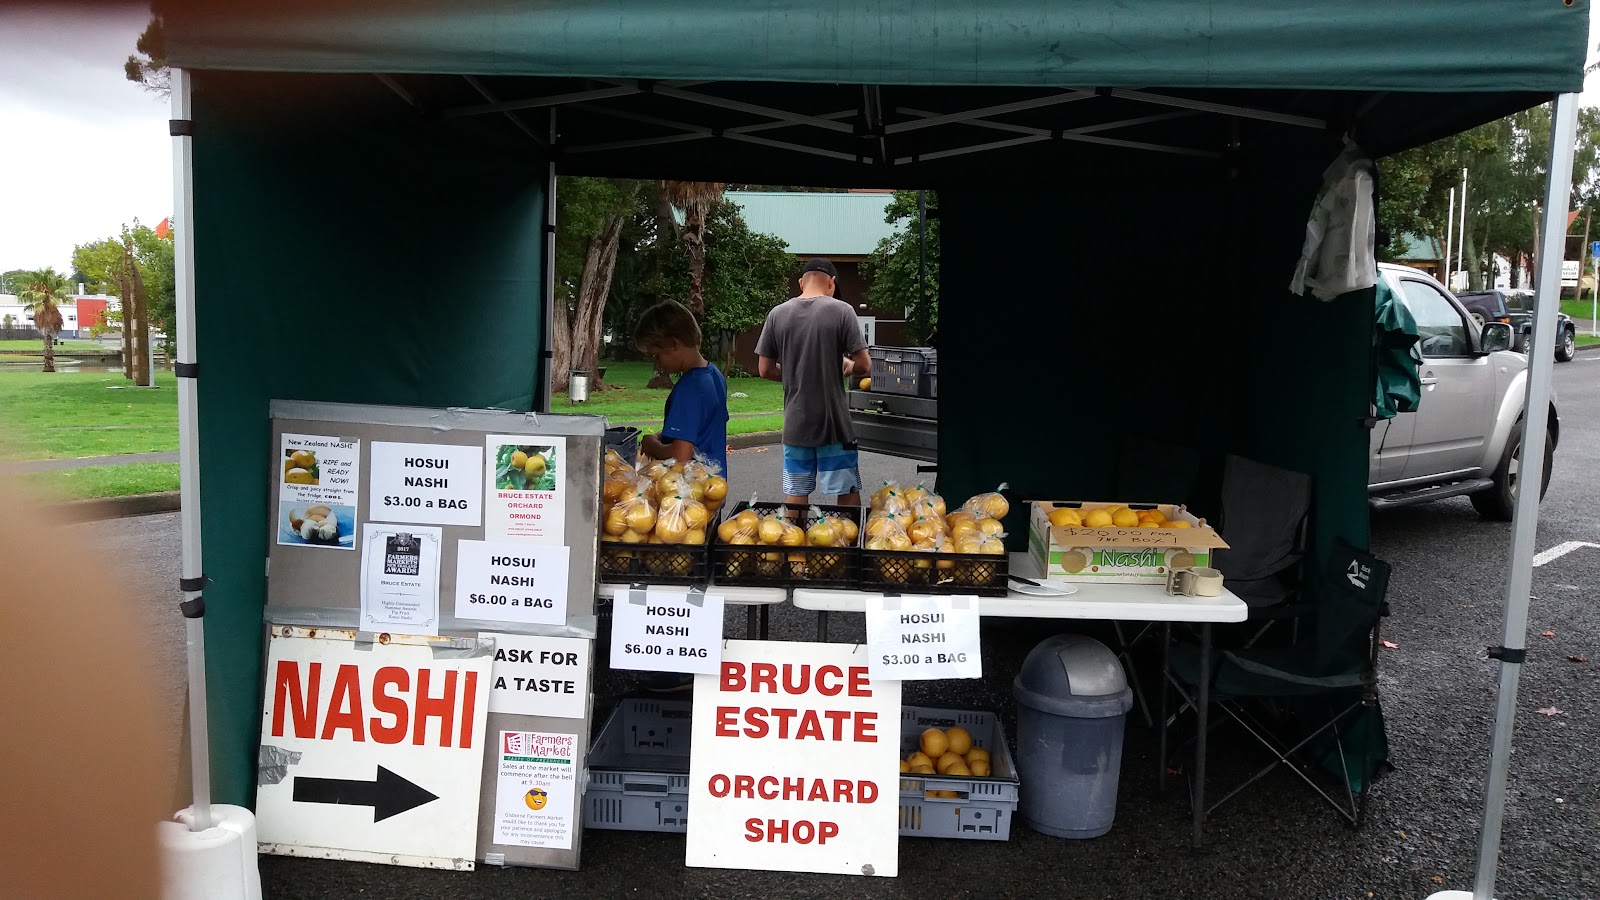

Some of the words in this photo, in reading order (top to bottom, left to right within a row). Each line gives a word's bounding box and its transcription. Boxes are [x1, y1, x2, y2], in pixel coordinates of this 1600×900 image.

[404, 457, 449, 469] HOSUI
[404, 476, 448, 488] NASHI
[384, 495, 421, 507] $3.00
[425, 500, 433, 508] a
[438, 498, 468, 510] BAG
[491, 556, 535, 568] HOSUI
[1100, 548, 1158, 568] Nashi
[491, 575, 534, 587] NASHI
[469, 593, 507, 605] $6.00
[511, 598, 519, 606] a
[524, 597, 553, 608] BAG
[646, 606, 690, 618] HOSUI
[900, 613, 944, 624] HOSUI
[646, 625, 689, 636] NASHI
[902, 633, 945, 644] NASHI
[494, 648, 533, 663] ASK
[540, 651, 578, 666] FOR
[624, 643, 662, 655] $6.00
[666, 648, 674, 656] a
[679, 647, 708, 658] BAG
[882, 654, 920, 666] $3.00
[925, 656, 932, 664] a
[938, 653, 967, 663] BAG
[494, 677, 507, 690] A
[513, 677, 575, 694] TASTE
[719, 661, 872, 697] BRUCE
[271, 660, 478, 749] NASHI
[715, 706, 878, 743] ESTATE
[532, 734, 572, 745] Farmers
[531, 744, 570, 757] Market
[708, 773, 879, 804] ORCHARD
[744, 818, 839, 845] SHOP
